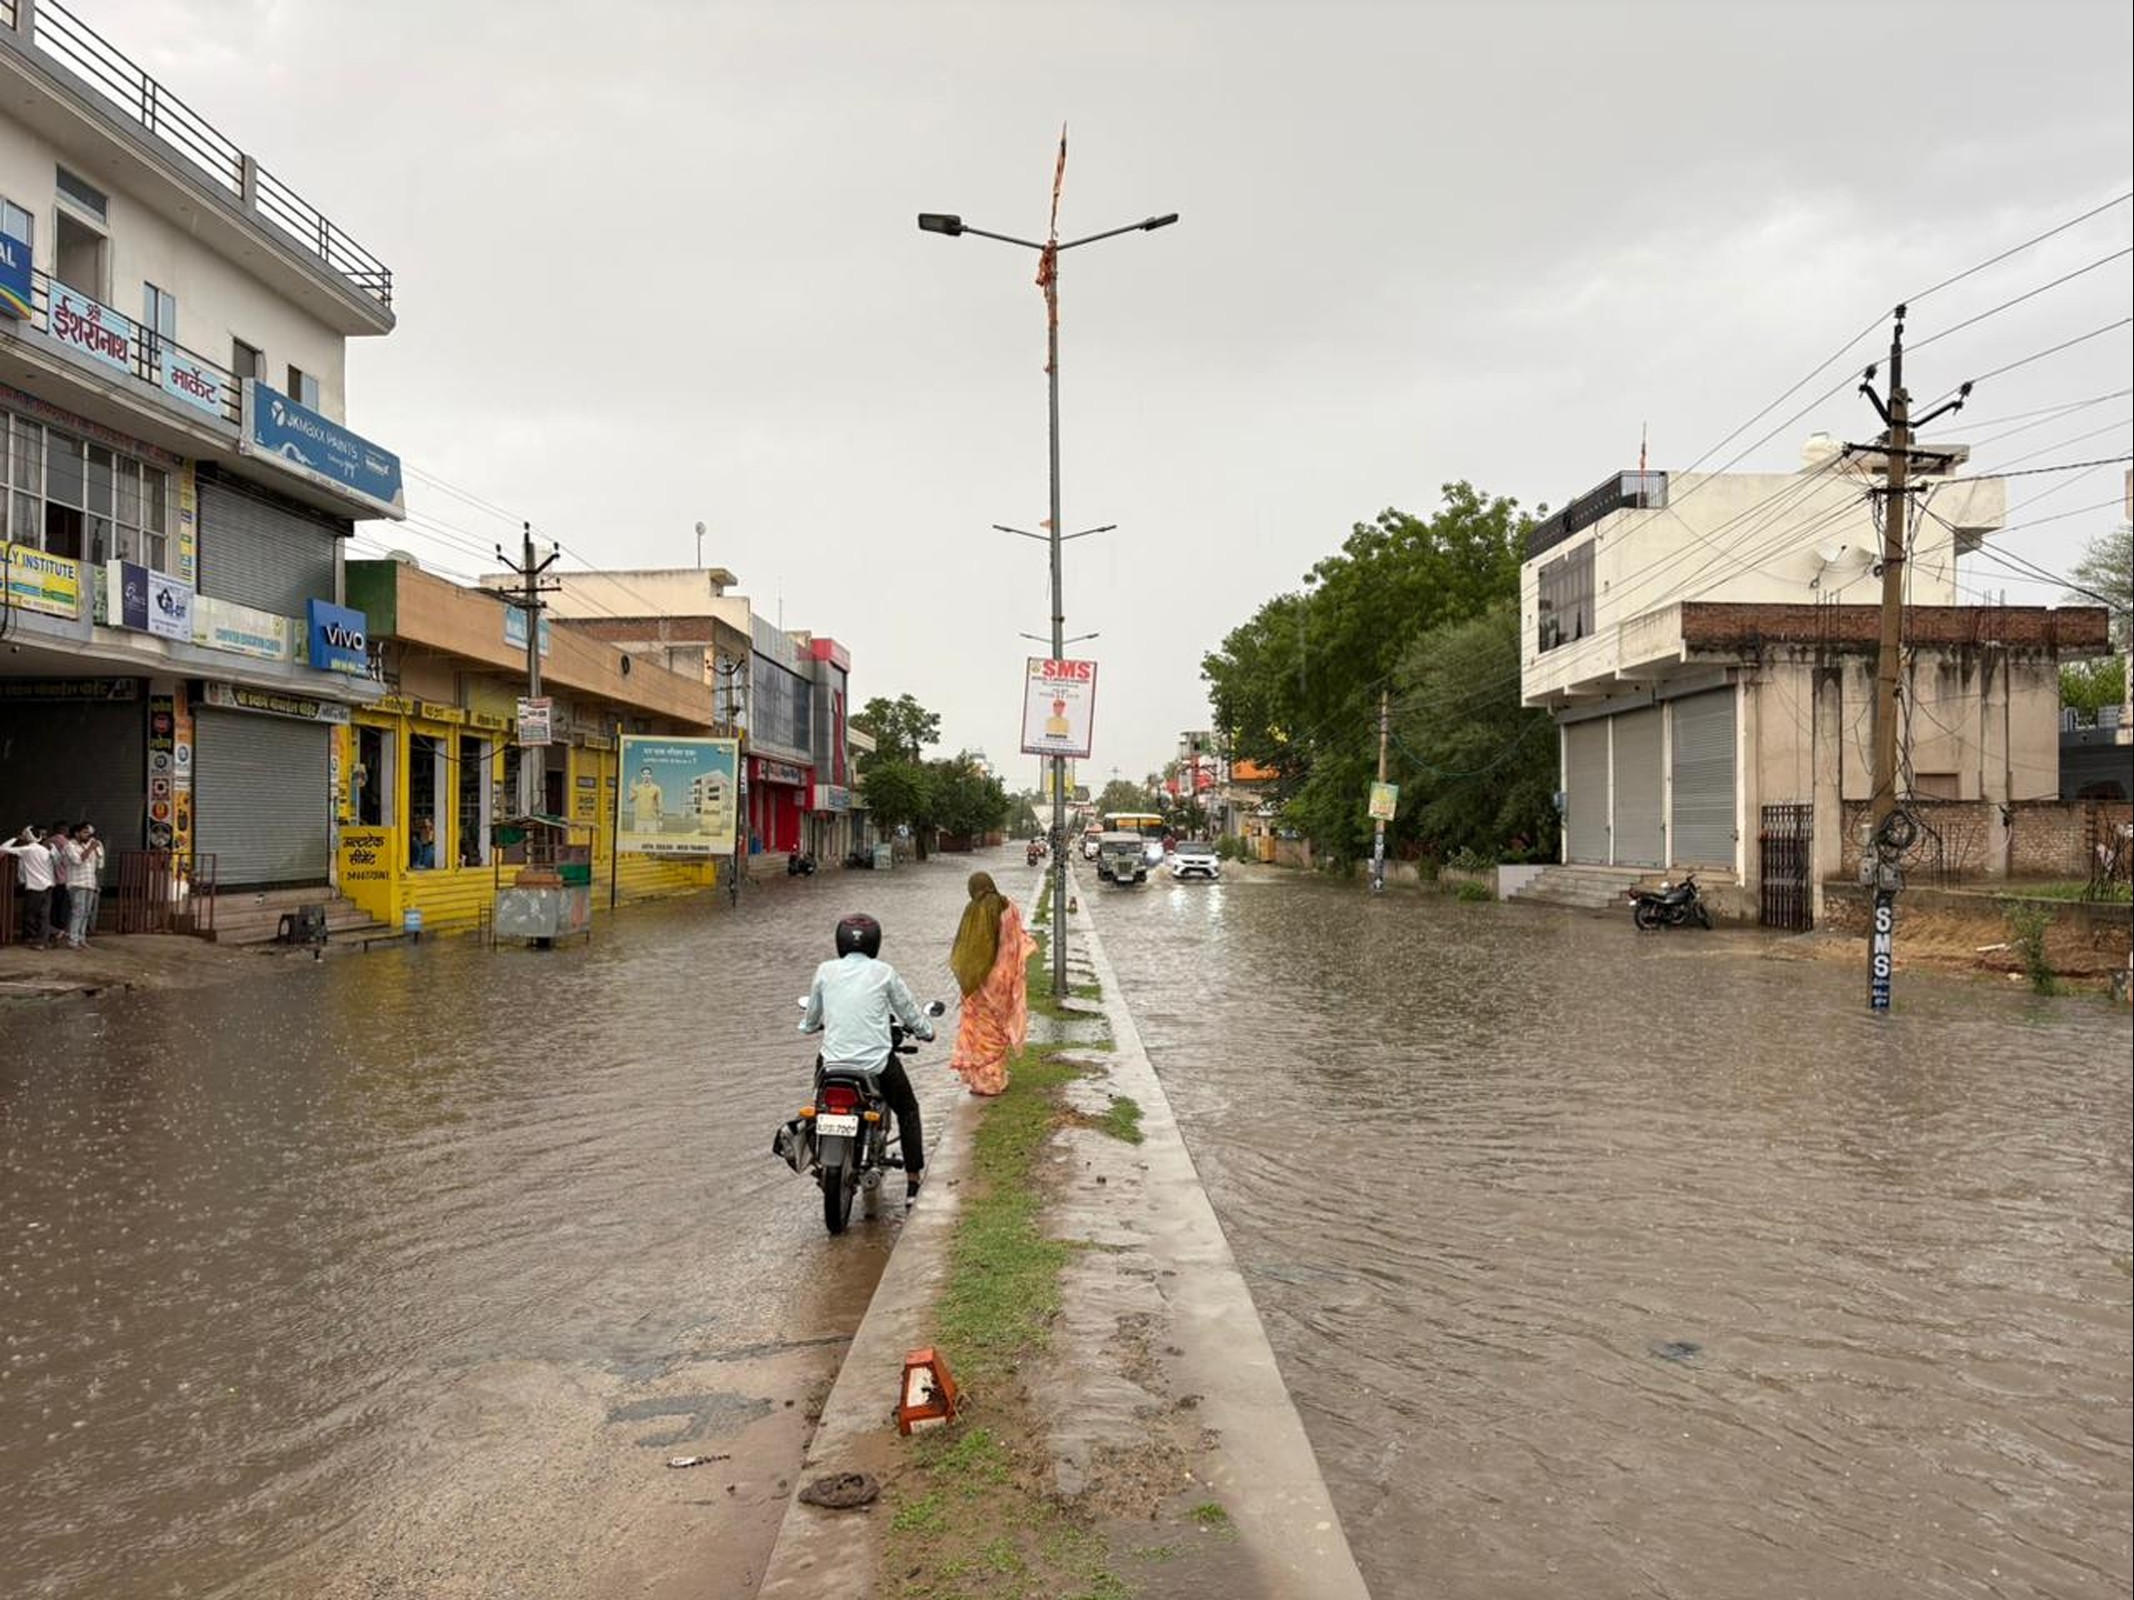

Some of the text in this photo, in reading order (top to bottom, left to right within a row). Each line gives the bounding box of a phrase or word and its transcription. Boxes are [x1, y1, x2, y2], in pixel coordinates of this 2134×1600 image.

[171, 365, 216, 404] मार्केट
[23, 554, 75, 580] INSTITUTE
[326, 621, 364, 651] vivo
[1042, 660, 1090, 679] SMS
[1874, 906, 1891, 978] SMS
